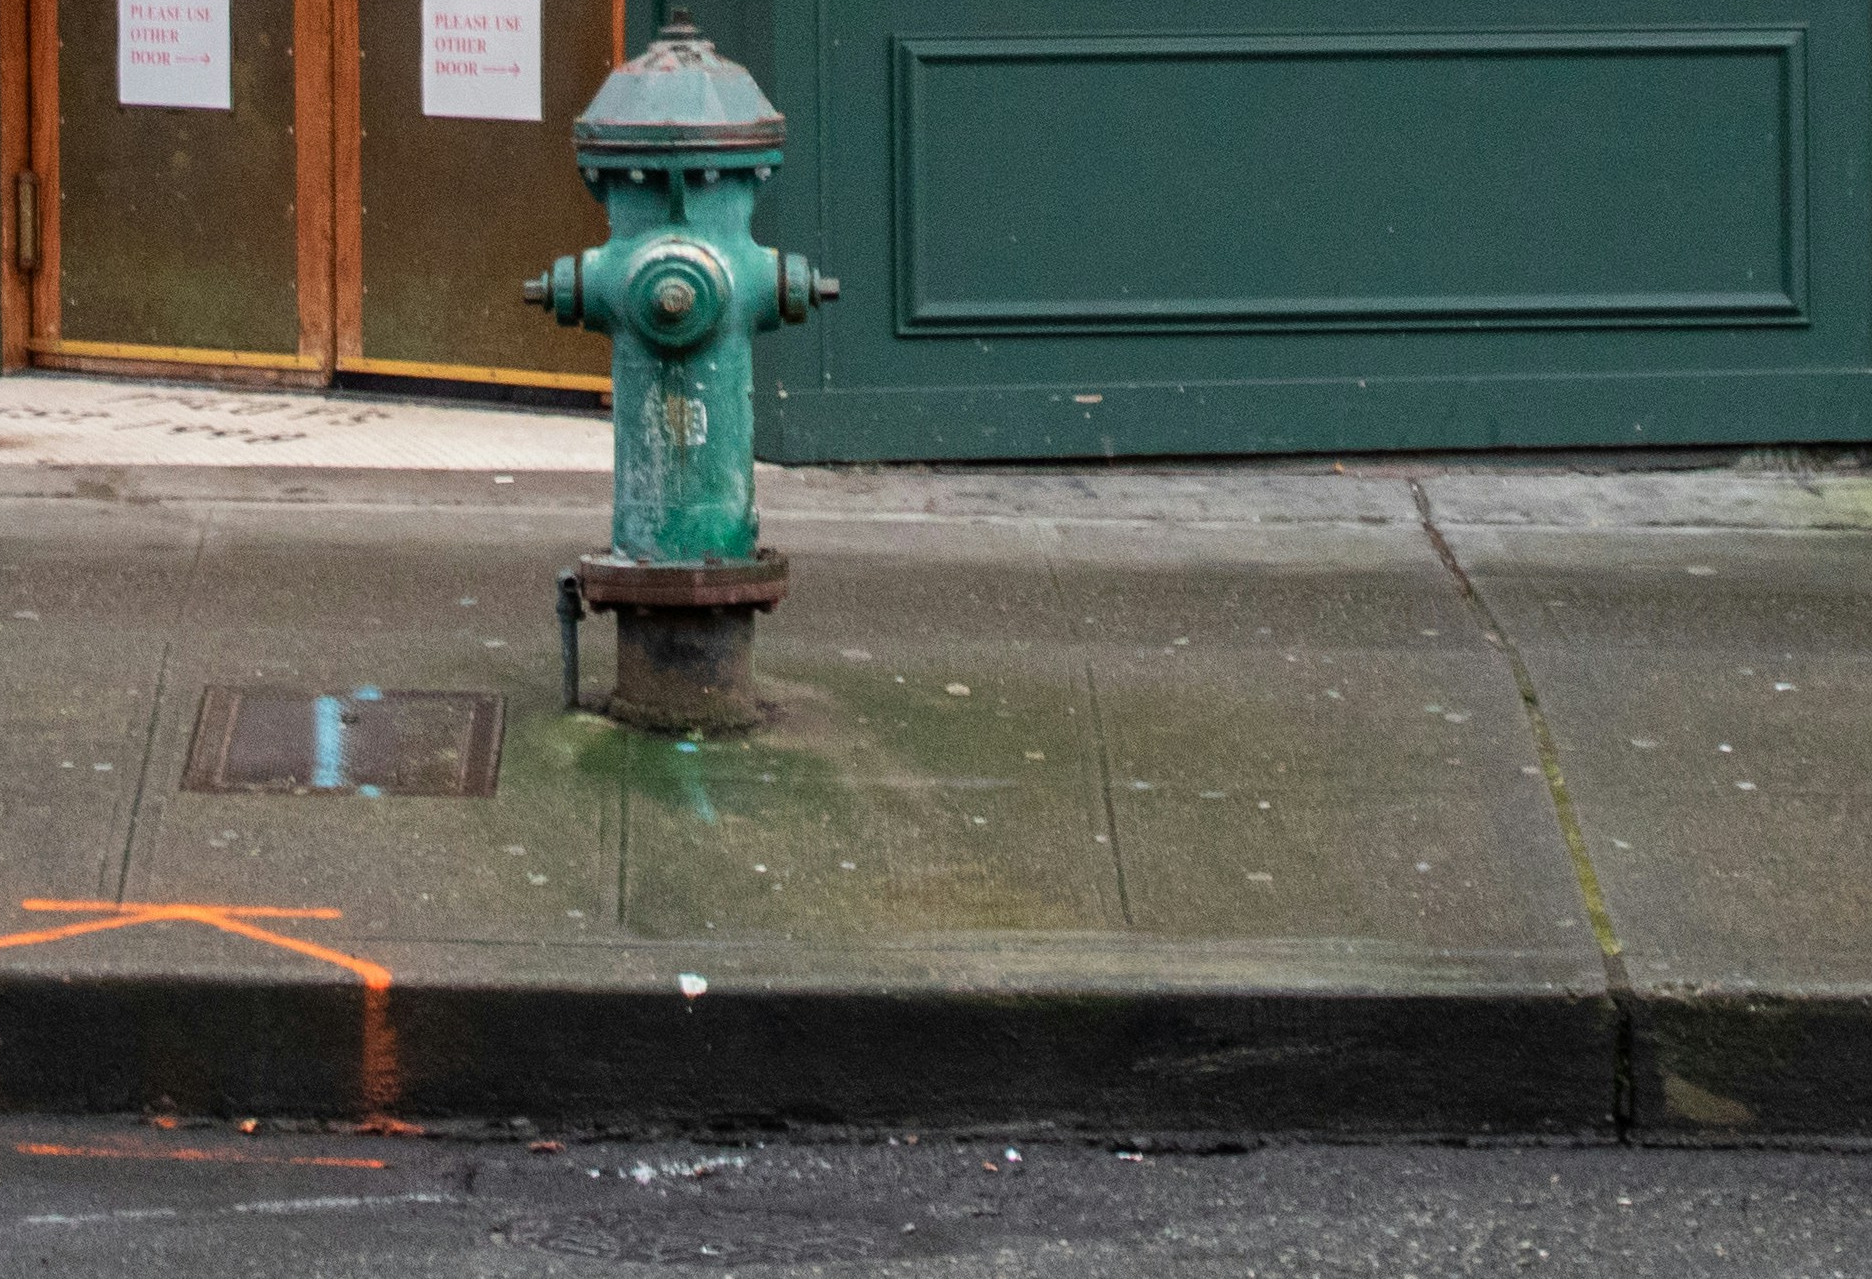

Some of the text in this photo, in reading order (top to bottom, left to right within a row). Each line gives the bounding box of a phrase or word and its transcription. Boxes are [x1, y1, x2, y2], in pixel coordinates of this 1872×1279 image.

[130, 2, 212, 23] PLEASE USE
[434, 13, 522, 31] PLEASE USE
[130, 27, 179, 43] OTHER
[434, 36, 487, 53] OTHER
[130, 50, 171, 65] DOOR
[434, 59, 478, 76] DOOR
